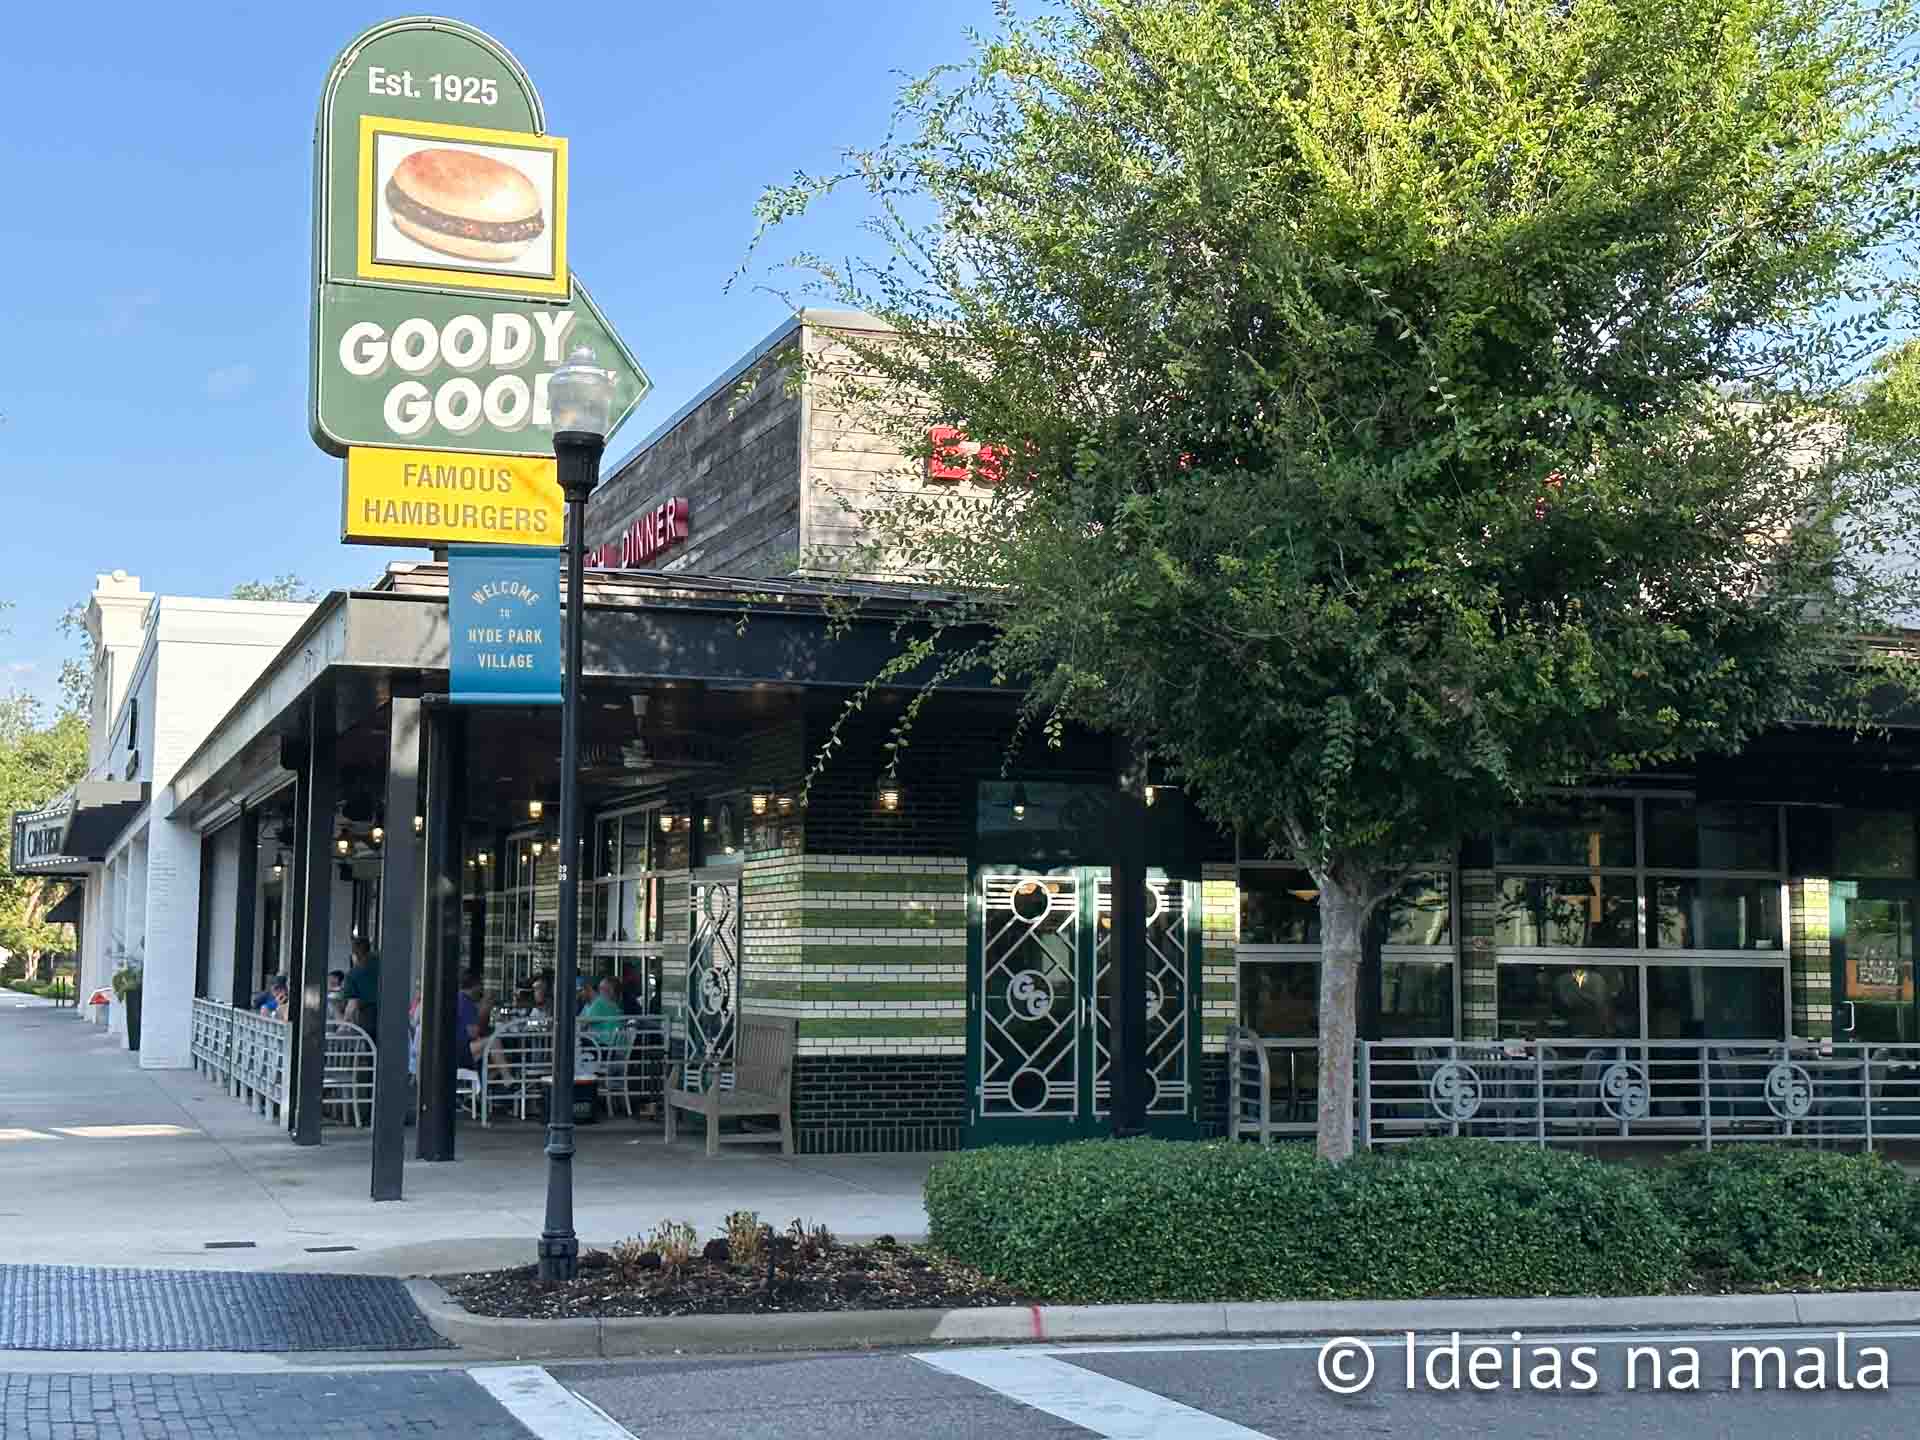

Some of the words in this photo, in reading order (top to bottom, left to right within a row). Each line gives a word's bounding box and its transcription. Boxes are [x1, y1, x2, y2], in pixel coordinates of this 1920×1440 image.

[368, 66, 420, 97] Est.
[429, 73, 498, 105] 1925
[340, 311, 576, 377] GOODY
[403, 463, 512, 493] FAMOUS
[363, 498, 548, 533] HAMBURGERS
[622, 497, 676, 569] DINNER
[472, 580, 541, 606] WELCOME
[467, 628, 503, 643] HYDE
[508, 629, 543, 644] PARK
[478, 653, 534, 669] VILLAGE
